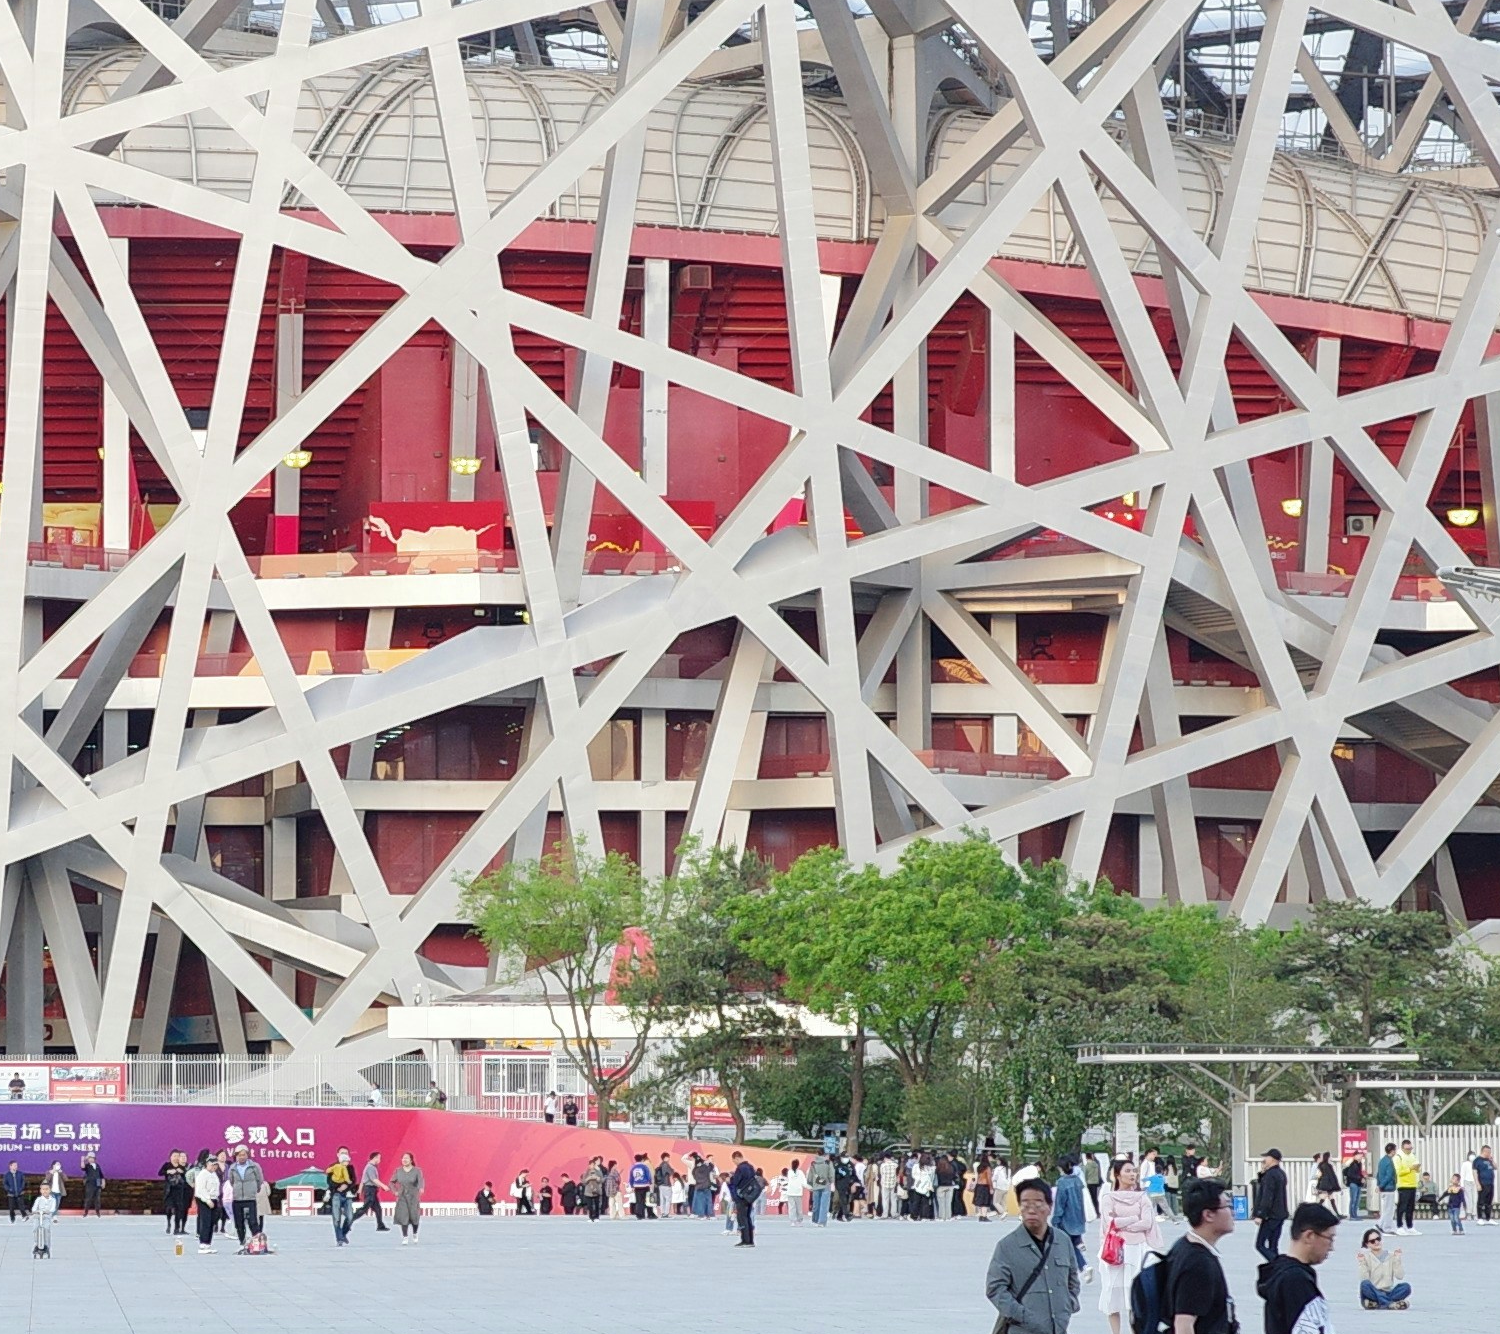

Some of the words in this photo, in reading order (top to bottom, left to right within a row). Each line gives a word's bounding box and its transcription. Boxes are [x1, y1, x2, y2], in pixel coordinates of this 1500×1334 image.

[224, 1125, 315, 1145] 参观入口
[33, 1143, 69, 1152] BIRD'S
[72, 1143, 101, 1152] NEST
[260, 1148, 315, 1159] Entrance
